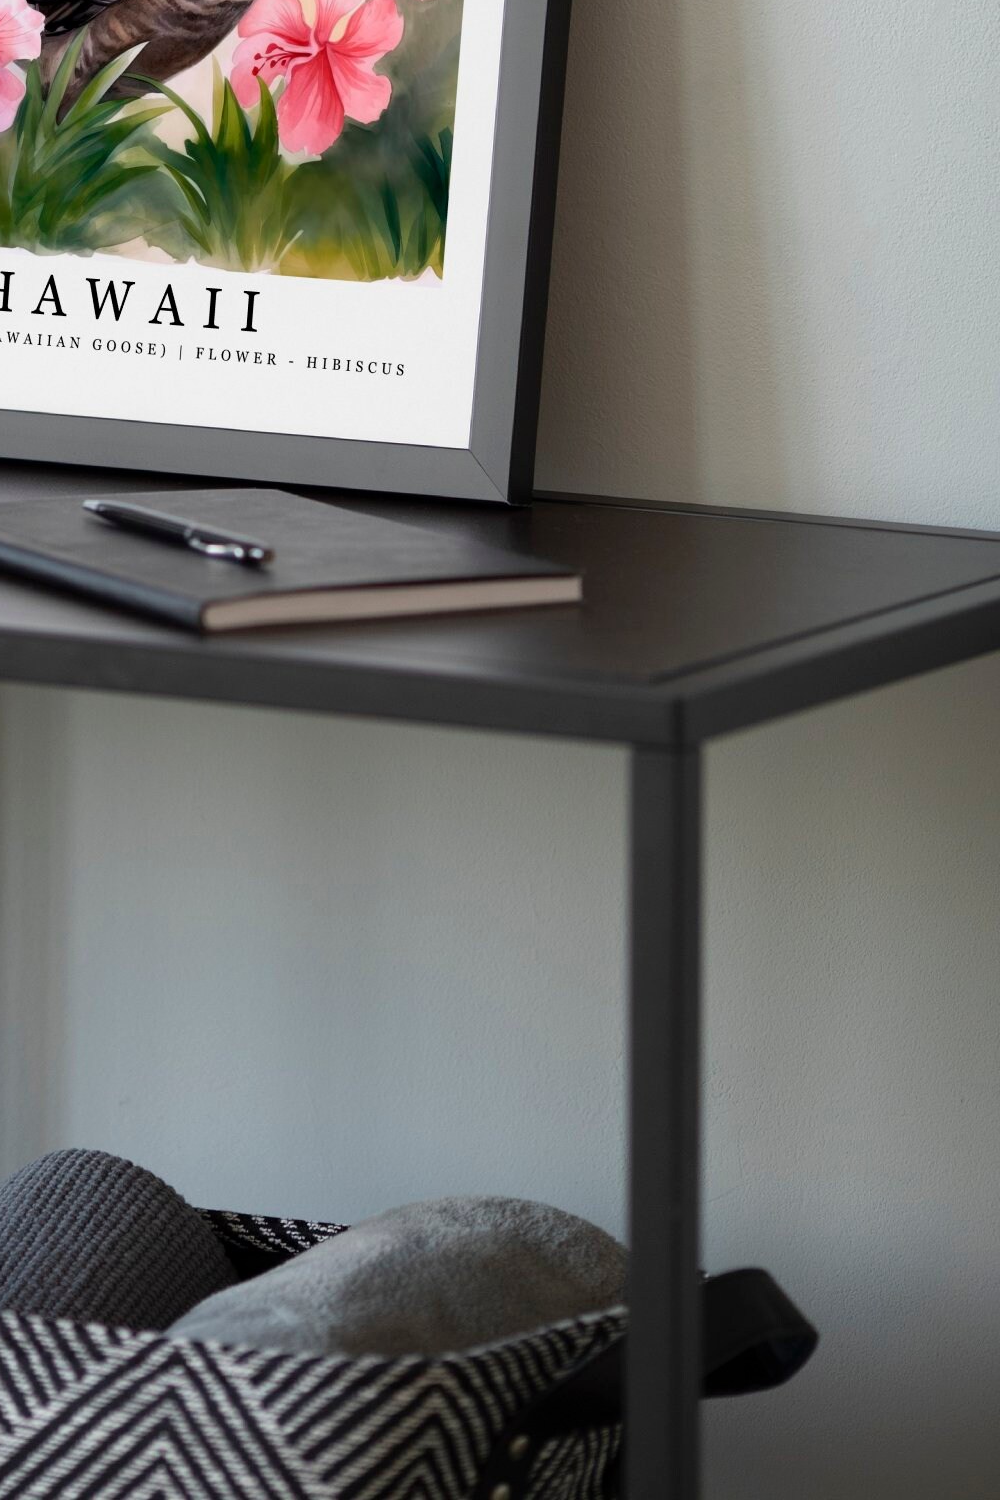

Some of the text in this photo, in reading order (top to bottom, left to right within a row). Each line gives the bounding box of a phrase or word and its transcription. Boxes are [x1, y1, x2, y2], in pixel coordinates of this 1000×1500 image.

[92, 338, 166, 358] GOOSE)
[195, 346, 277, 366] FLOWER
[306, 356, 405, 377] HIBISCUS
